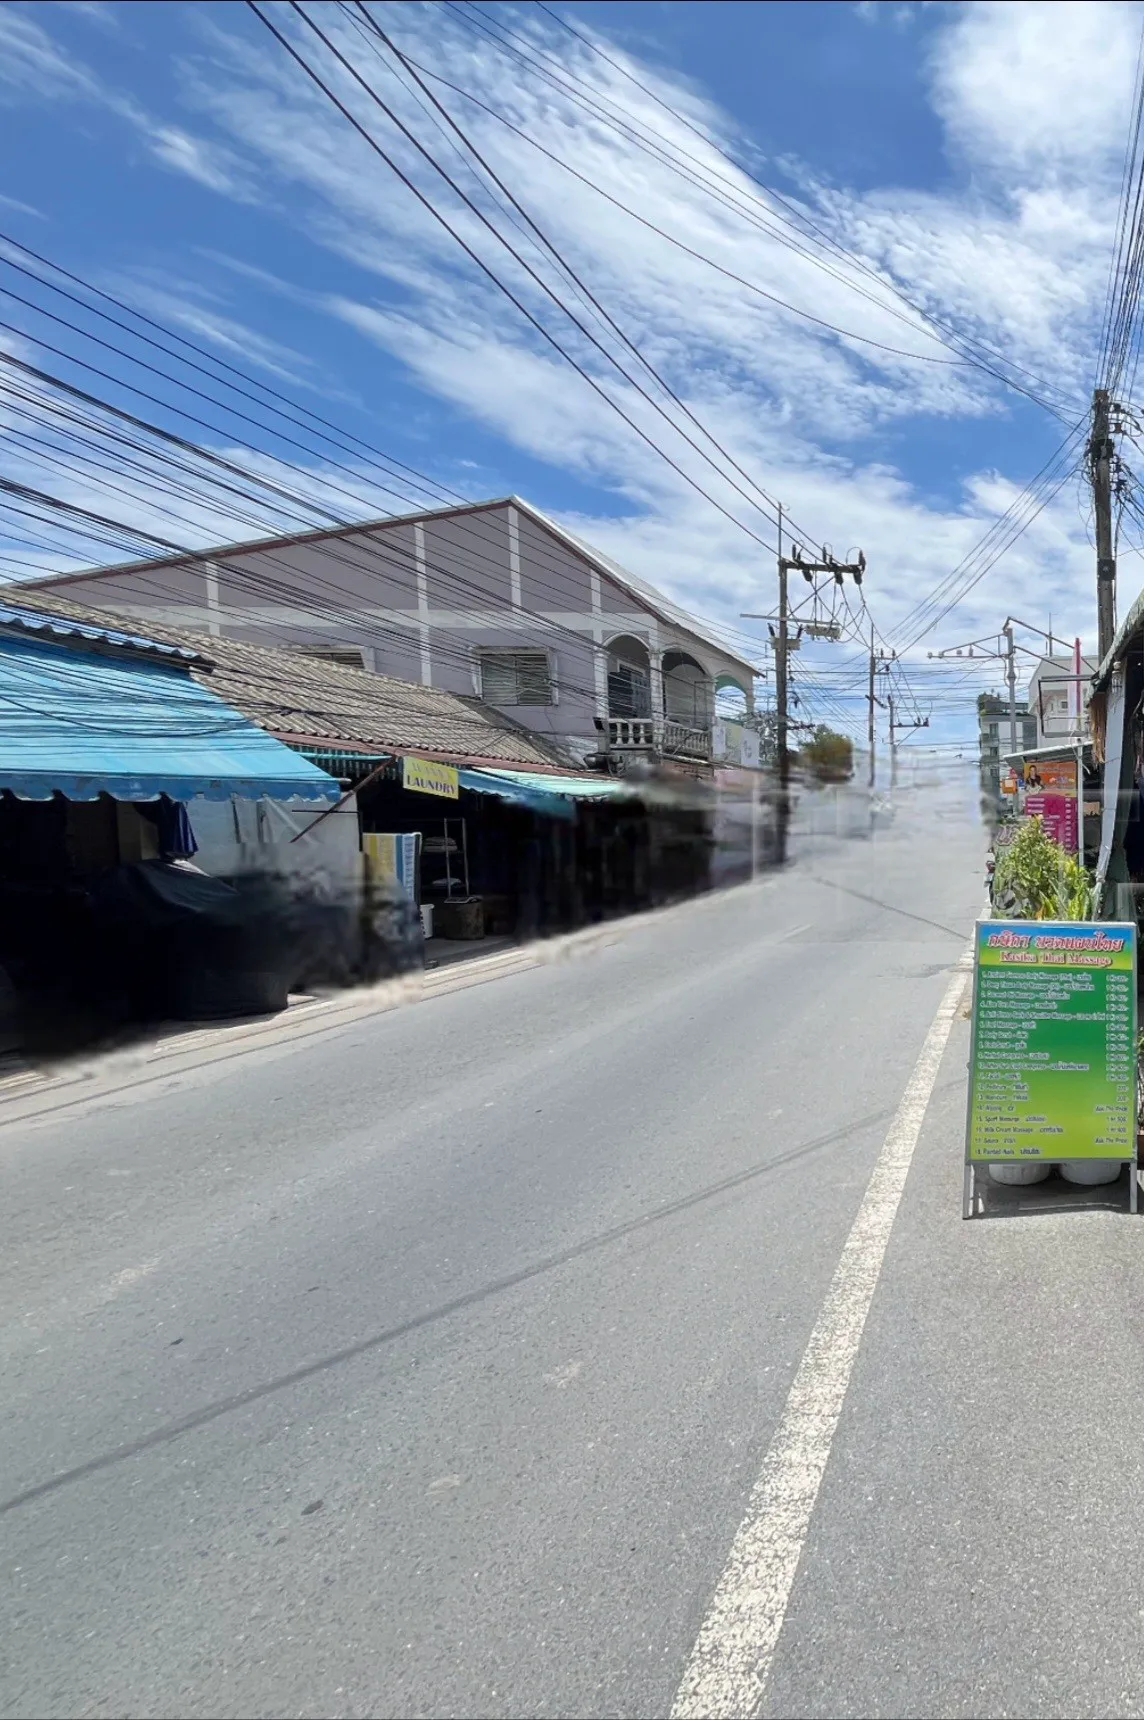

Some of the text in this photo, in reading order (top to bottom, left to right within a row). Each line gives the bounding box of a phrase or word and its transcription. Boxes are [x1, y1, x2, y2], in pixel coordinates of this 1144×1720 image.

[406, 775, 455, 795] LAUNDRY
[1001, 951, 1112, 968] Kasika Thai Massage
